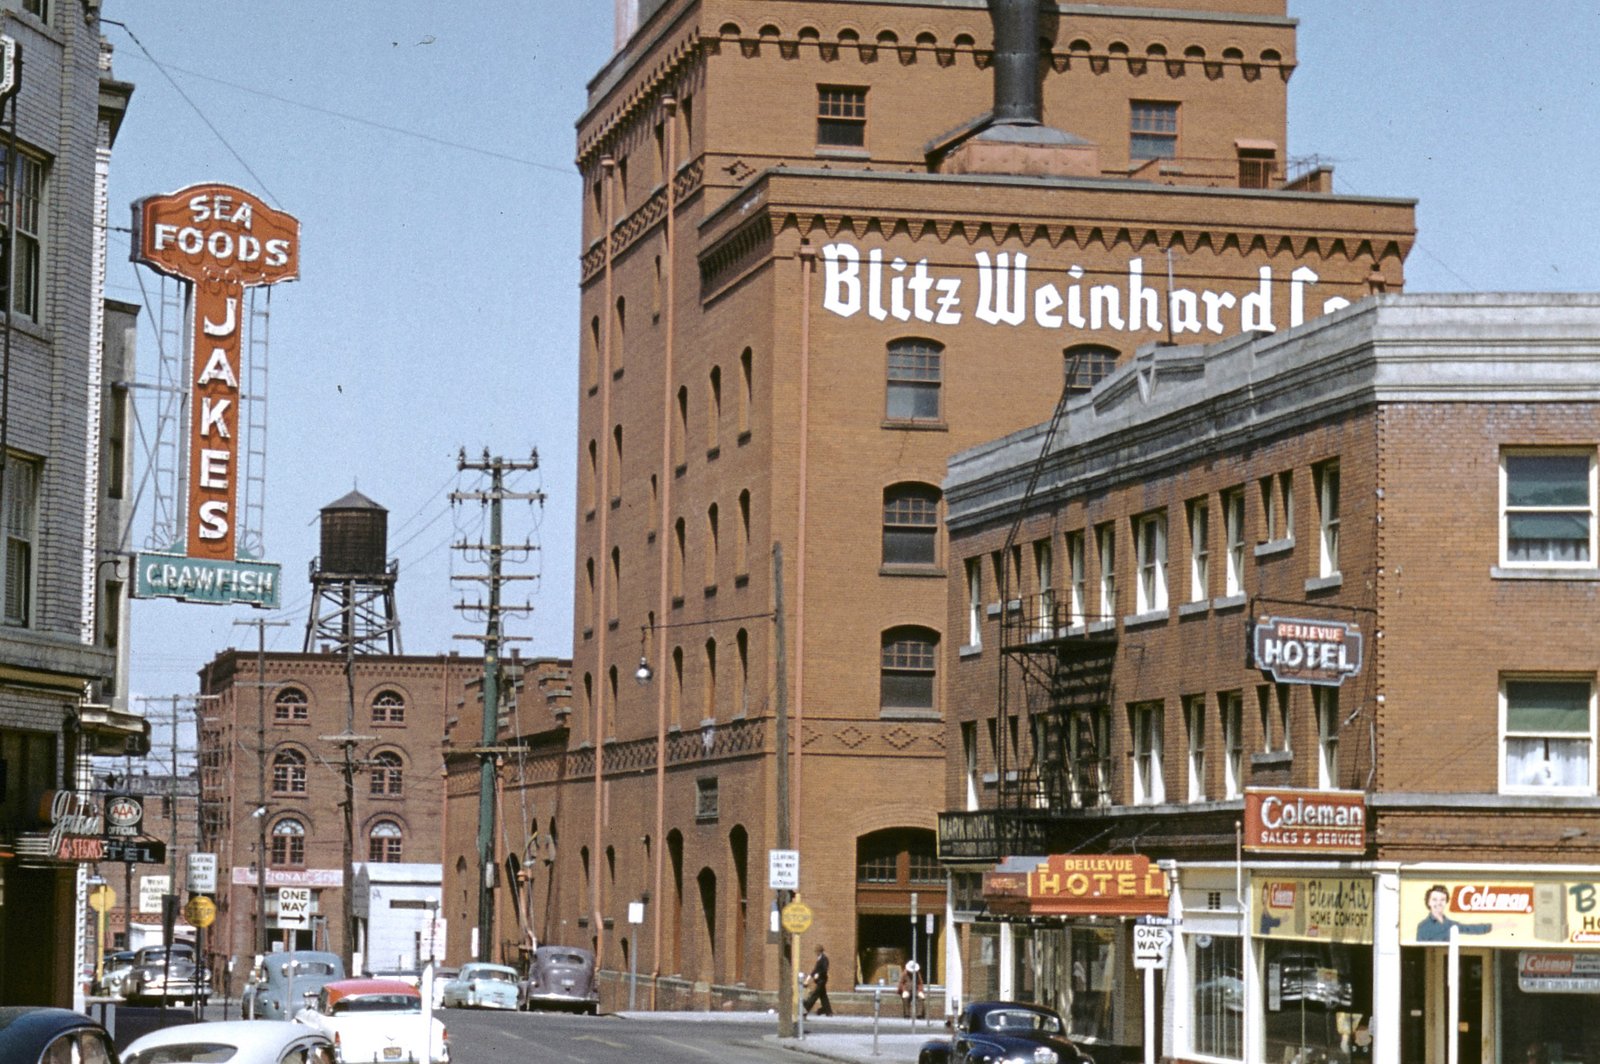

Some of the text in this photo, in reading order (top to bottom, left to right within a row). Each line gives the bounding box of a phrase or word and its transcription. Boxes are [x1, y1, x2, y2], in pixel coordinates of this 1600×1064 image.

[189, 194, 253, 230] SEA
[154, 223, 291, 267] FOODS
[822, 243, 962, 325] Blitz
[975, 251, 1277, 334] Weinhard
[198, 297, 238, 539] JAKES
[146, 562, 273, 594] CRAWFISH
[1278, 623, 1344, 642] BELLEVUE
[1264, 638, 1355, 670] HOTEL
[112, 803, 134, 818] AAA
[1260, 796, 1362, 830] Coleman
[107, 825, 138, 836] OFFICIAL
[1261, 830, 1362, 846] SALES & SERVICE
[1064, 859, 1133, 872] BELLEVUE
[1039, 873, 1163, 896] HOTEL
[281, 890, 308, 900] ONE
[1457, 886, 1531, 913] Coleman
[280, 902, 308, 912] WAY
[1310, 910, 1368, 927] HOME COMFORT
[1137, 928, 1164, 938] ONE
[1137, 941, 1164, 950] WAY
